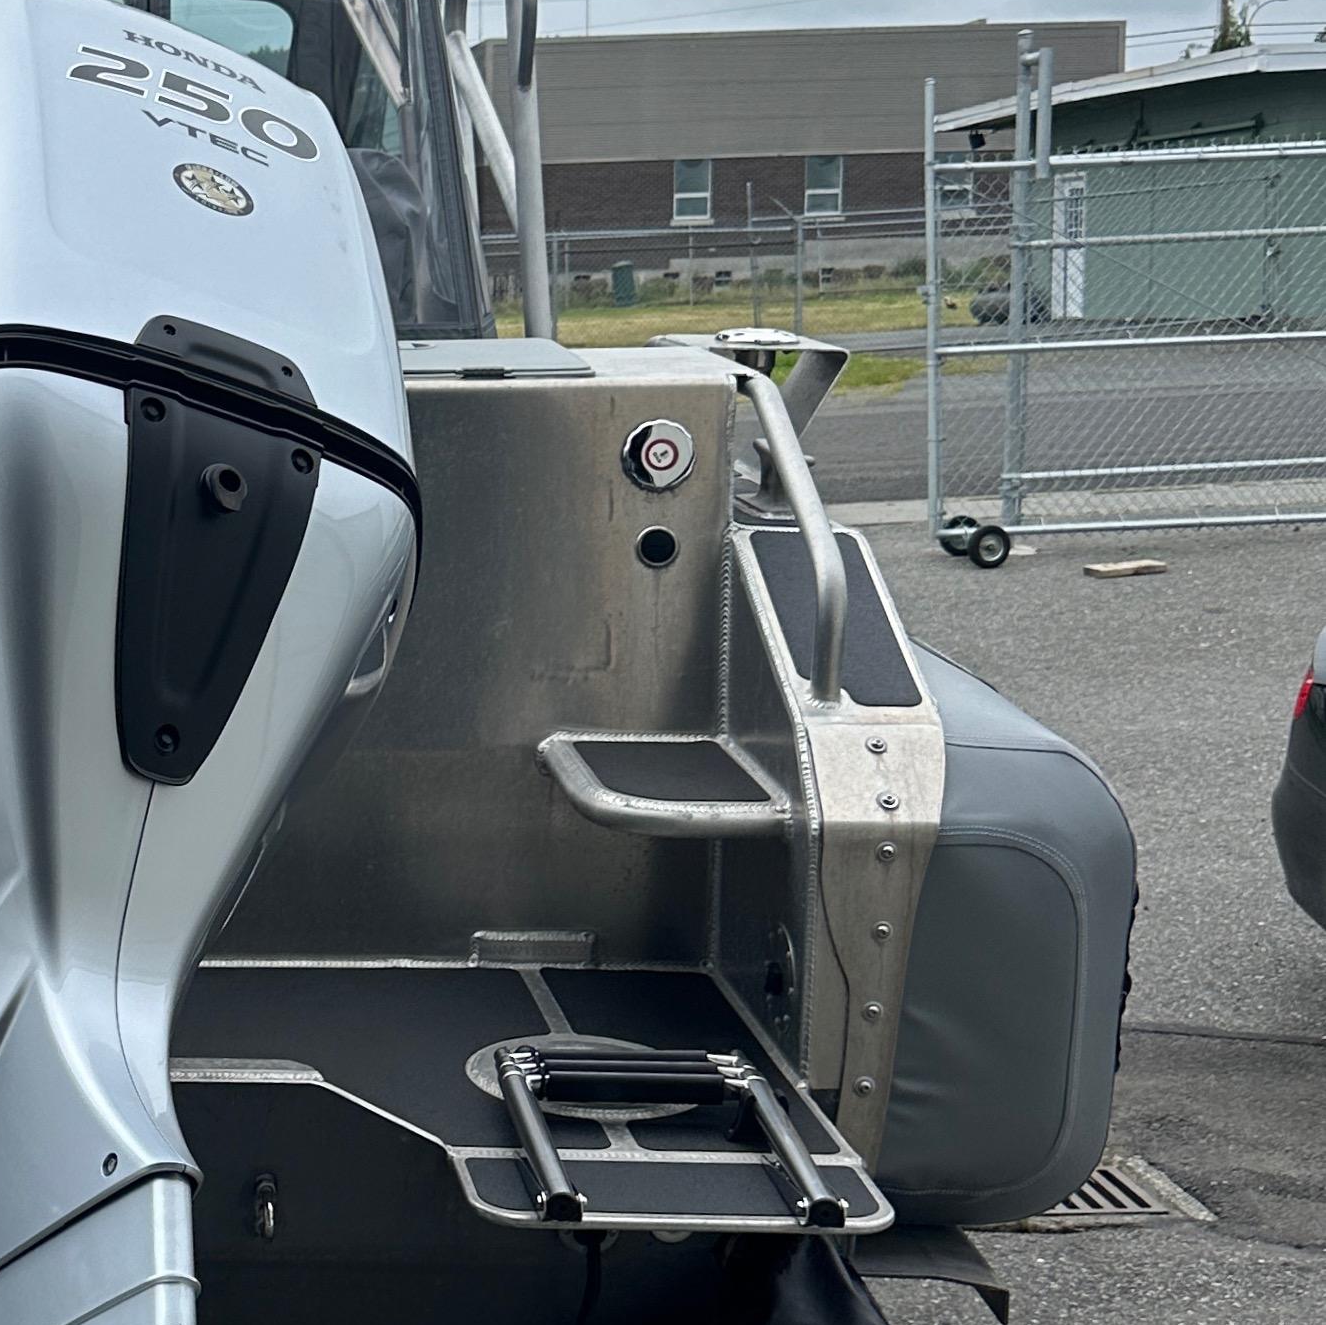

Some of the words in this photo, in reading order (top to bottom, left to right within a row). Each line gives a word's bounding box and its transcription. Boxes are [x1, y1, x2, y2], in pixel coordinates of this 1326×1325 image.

[122, 29, 266, 94] HONDA
[66, 43, 321, 162] 250
[141, 109, 269, 168] VTEC
